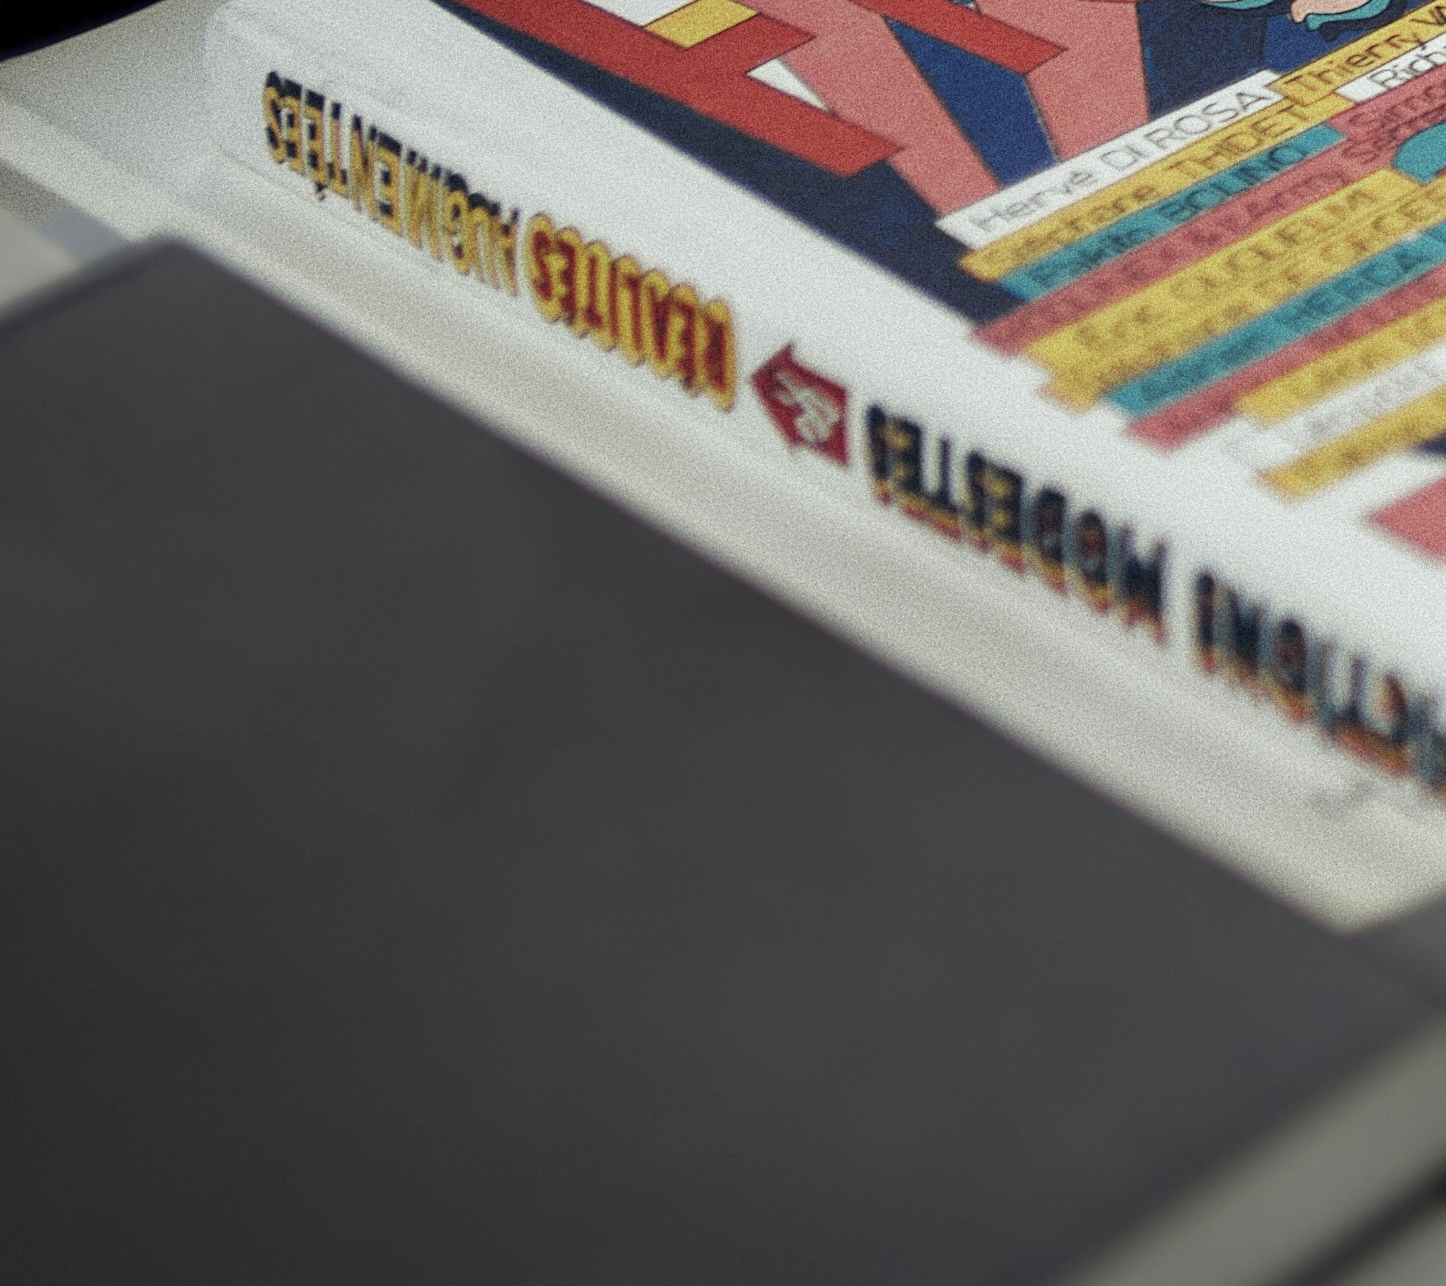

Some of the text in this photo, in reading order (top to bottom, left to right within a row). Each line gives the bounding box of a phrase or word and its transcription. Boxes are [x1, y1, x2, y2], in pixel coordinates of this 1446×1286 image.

[1282, 26, 1437, 94] Thierry
[963, 86, 1275, 233] Hervé DI ROSA
